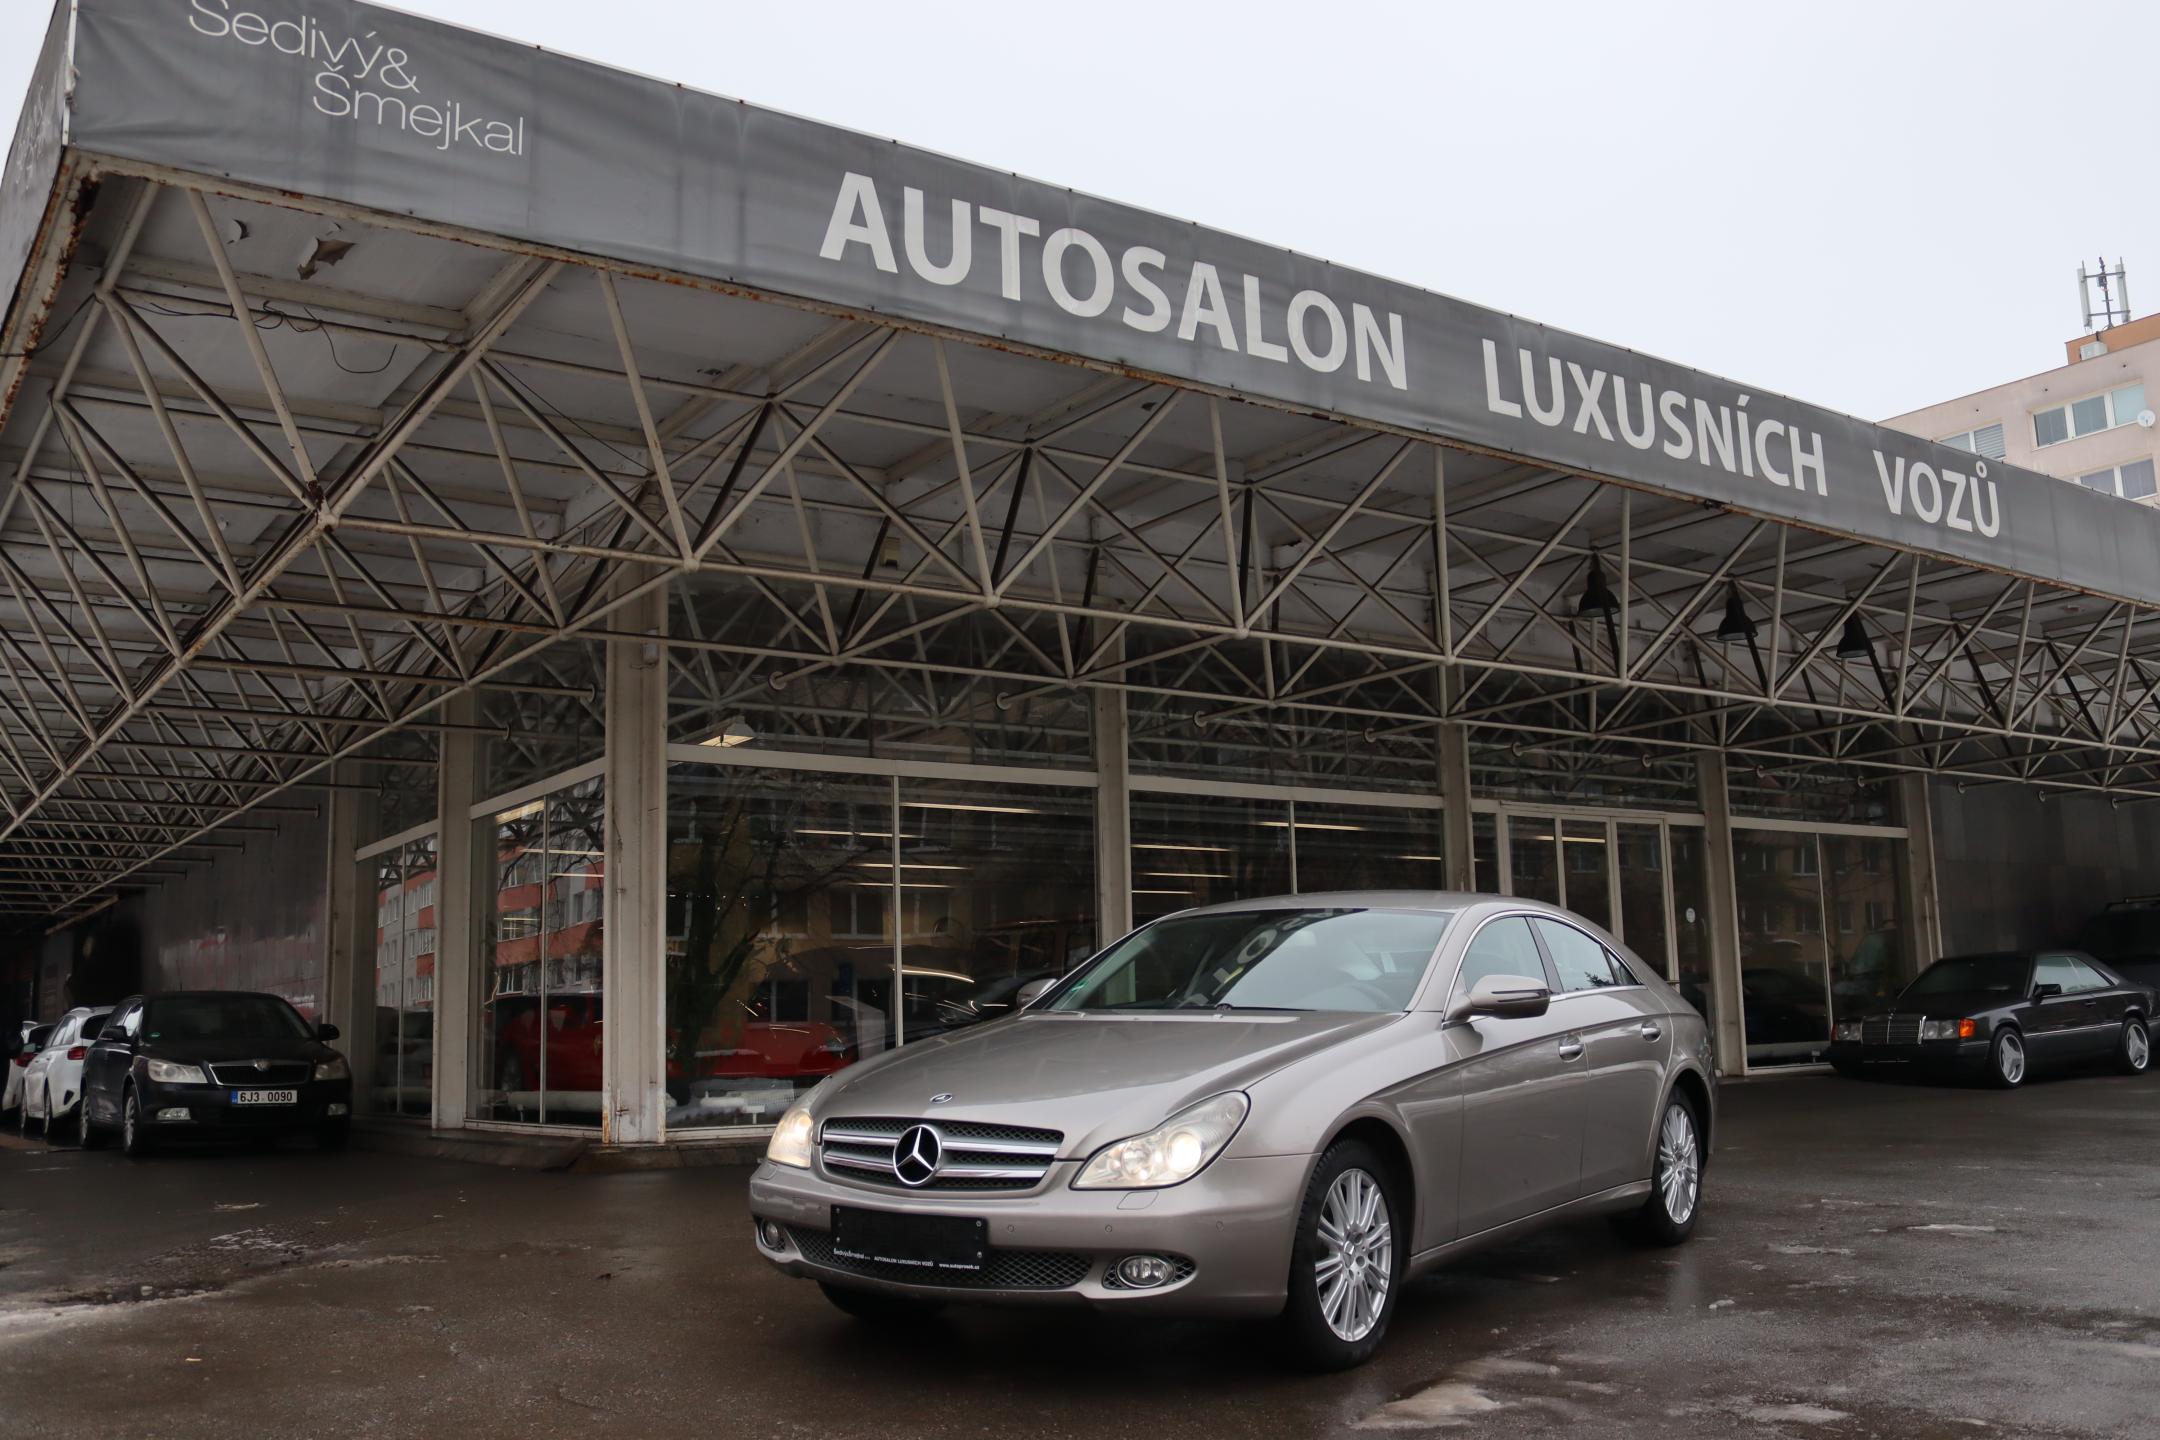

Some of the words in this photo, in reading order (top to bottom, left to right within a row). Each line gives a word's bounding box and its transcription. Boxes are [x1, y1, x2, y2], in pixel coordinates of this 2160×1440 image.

[313, 61, 524, 156] Šmejkal
[818, 171, 1408, 390] AUTOSALON
[1482, 338, 1828, 496] LUXUSNÍCH
[1873, 460, 2001, 538] VOZŮ
[240, 1092, 260, 1102] 6J3
[267, 1091, 293, 1102] 0090
